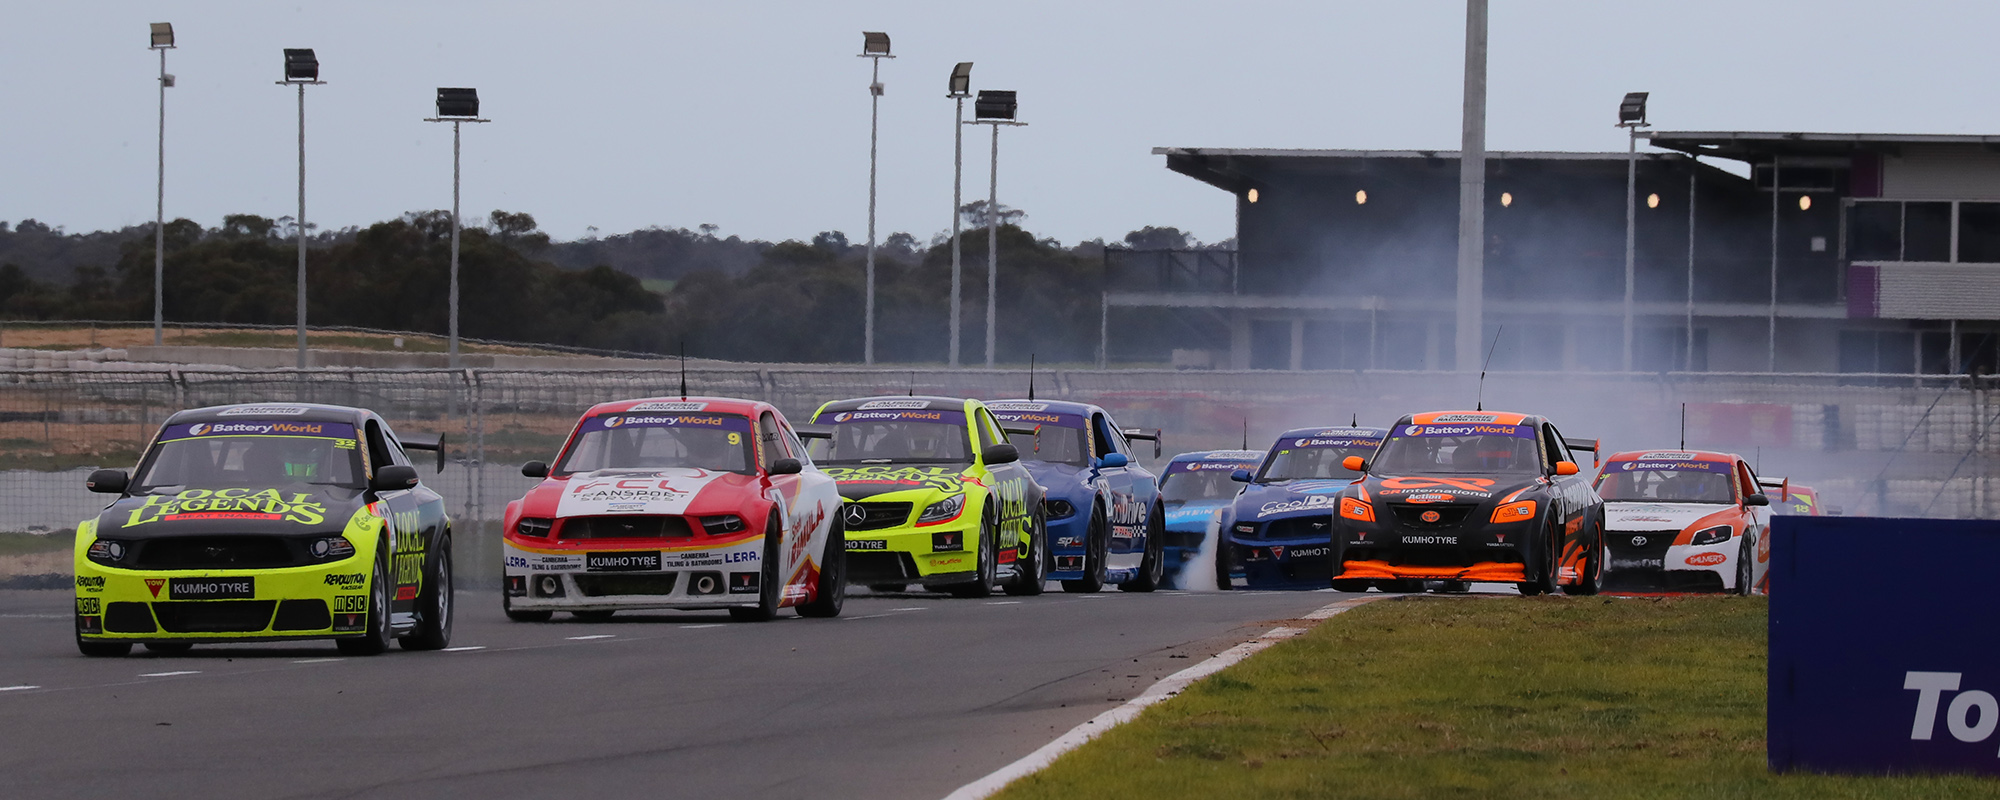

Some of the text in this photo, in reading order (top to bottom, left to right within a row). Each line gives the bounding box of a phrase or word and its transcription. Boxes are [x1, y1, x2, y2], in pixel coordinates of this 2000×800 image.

[625, 416, 723, 425] BatteryWorld
[853, 412, 941, 420] BatteryWorld
[995, 414, 1059, 422] teryWorld
[212, 423, 323, 434] BatteryWorld
[1425, 425, 1516, 435] BatteryWorld
[727, 433, 740, 445] 9
[1311, 439, 1381, 447] BatteryWorl
[819, 466, 960, 477] OCAL
[144, 488, 321, 507] LOCAL
[571, 490, 689, 498] TRANSPORT
[121, 498, 327, 528] LEGENDS
[1794, 504, 1810, 513] 18
[858, 540, 883, 549] TYRE
[1402, 536, 1458, 545] KUMHO TYRE
[1291, 548, 1321, 557] KUMHO
[590, 556, 657, 567] KUMHO TYRE
[173, 582, 250, 594] KUMHO TYRE
[1903, 671, 2000, 758] To
